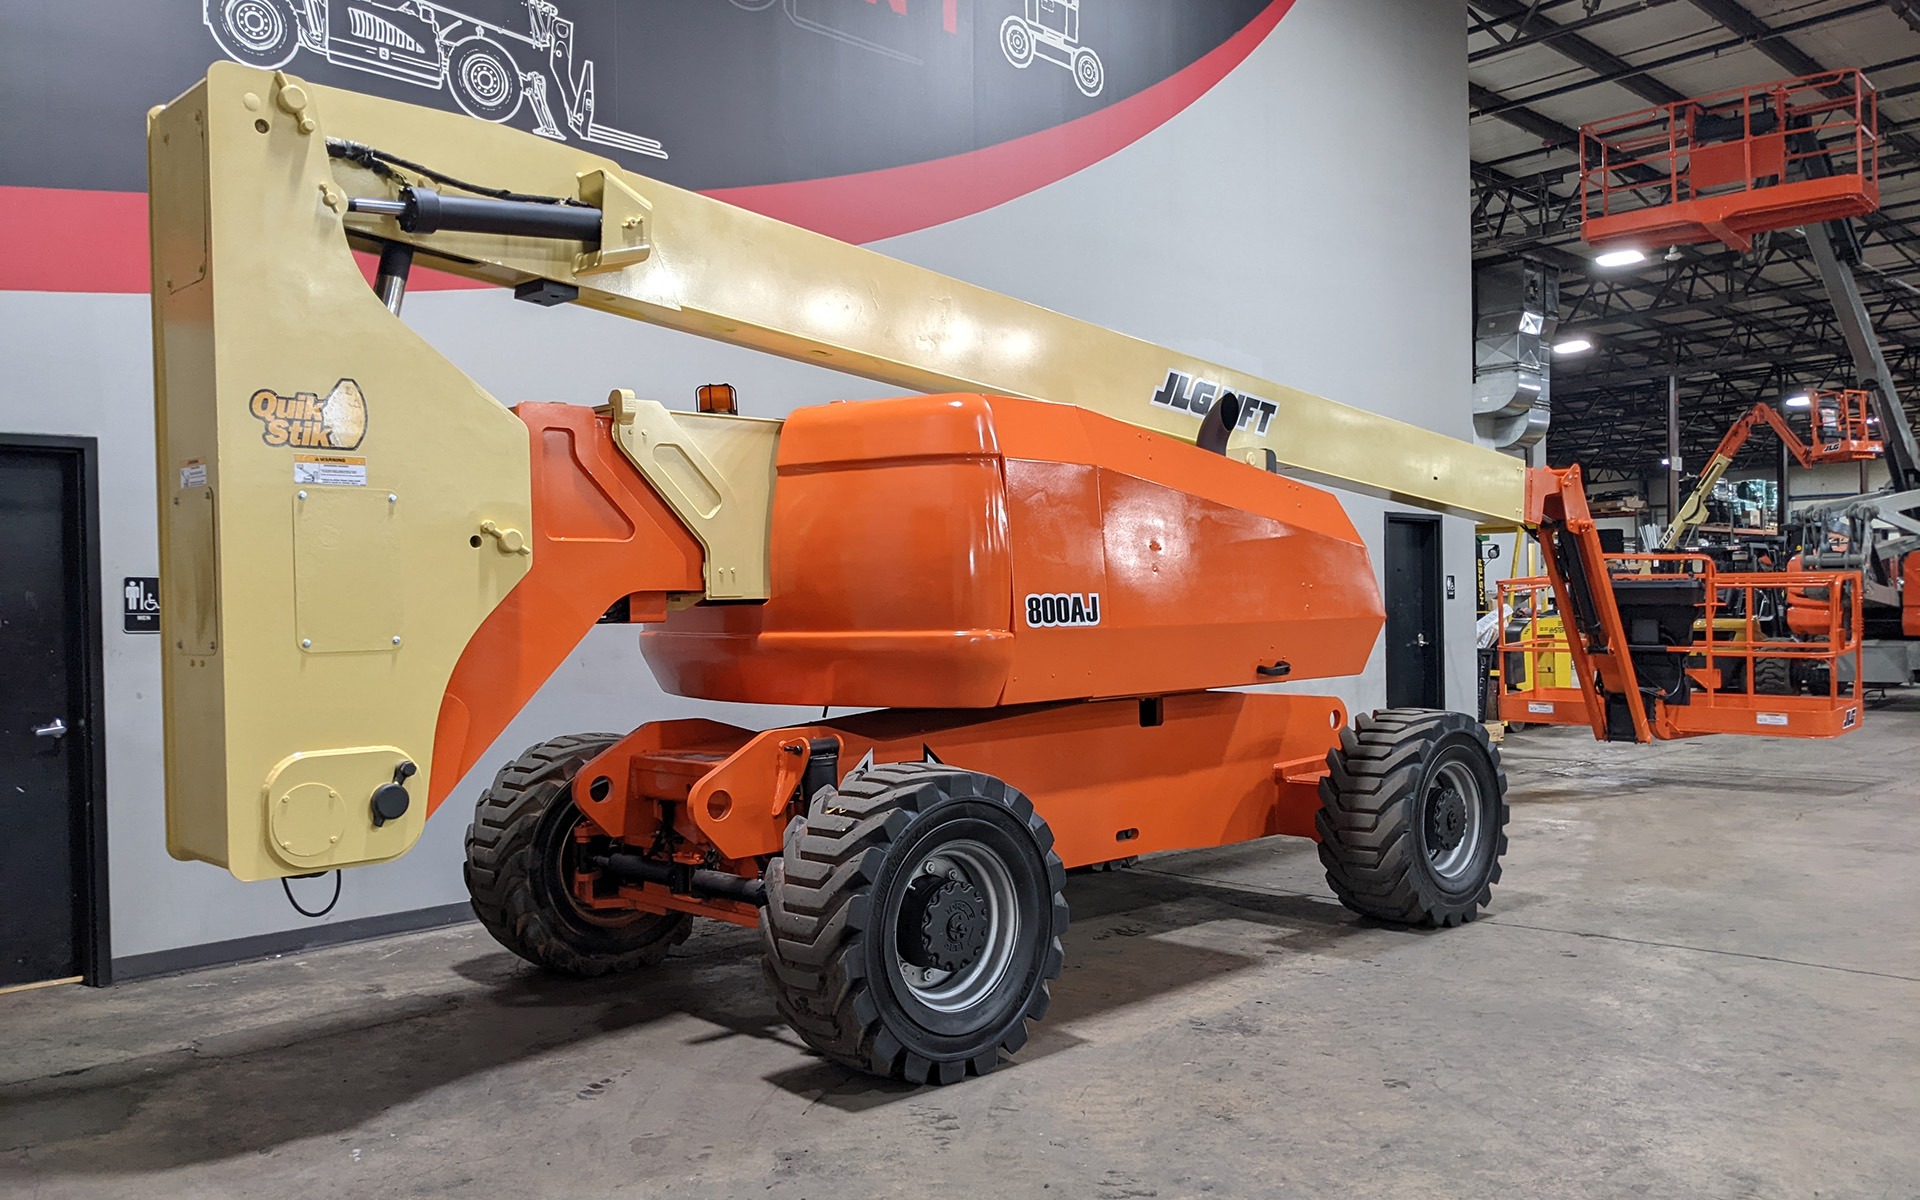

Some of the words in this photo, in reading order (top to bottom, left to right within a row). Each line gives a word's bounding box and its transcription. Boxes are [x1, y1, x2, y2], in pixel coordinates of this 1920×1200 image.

[250, 389, 325, 421] Quik
[1152, 370, 1219, 417] JLG
[263, 419, 332, 447] Stik
[1824, 443, 1840, 452] JLG
[1027, 595, 1099, 625] 800AJ
